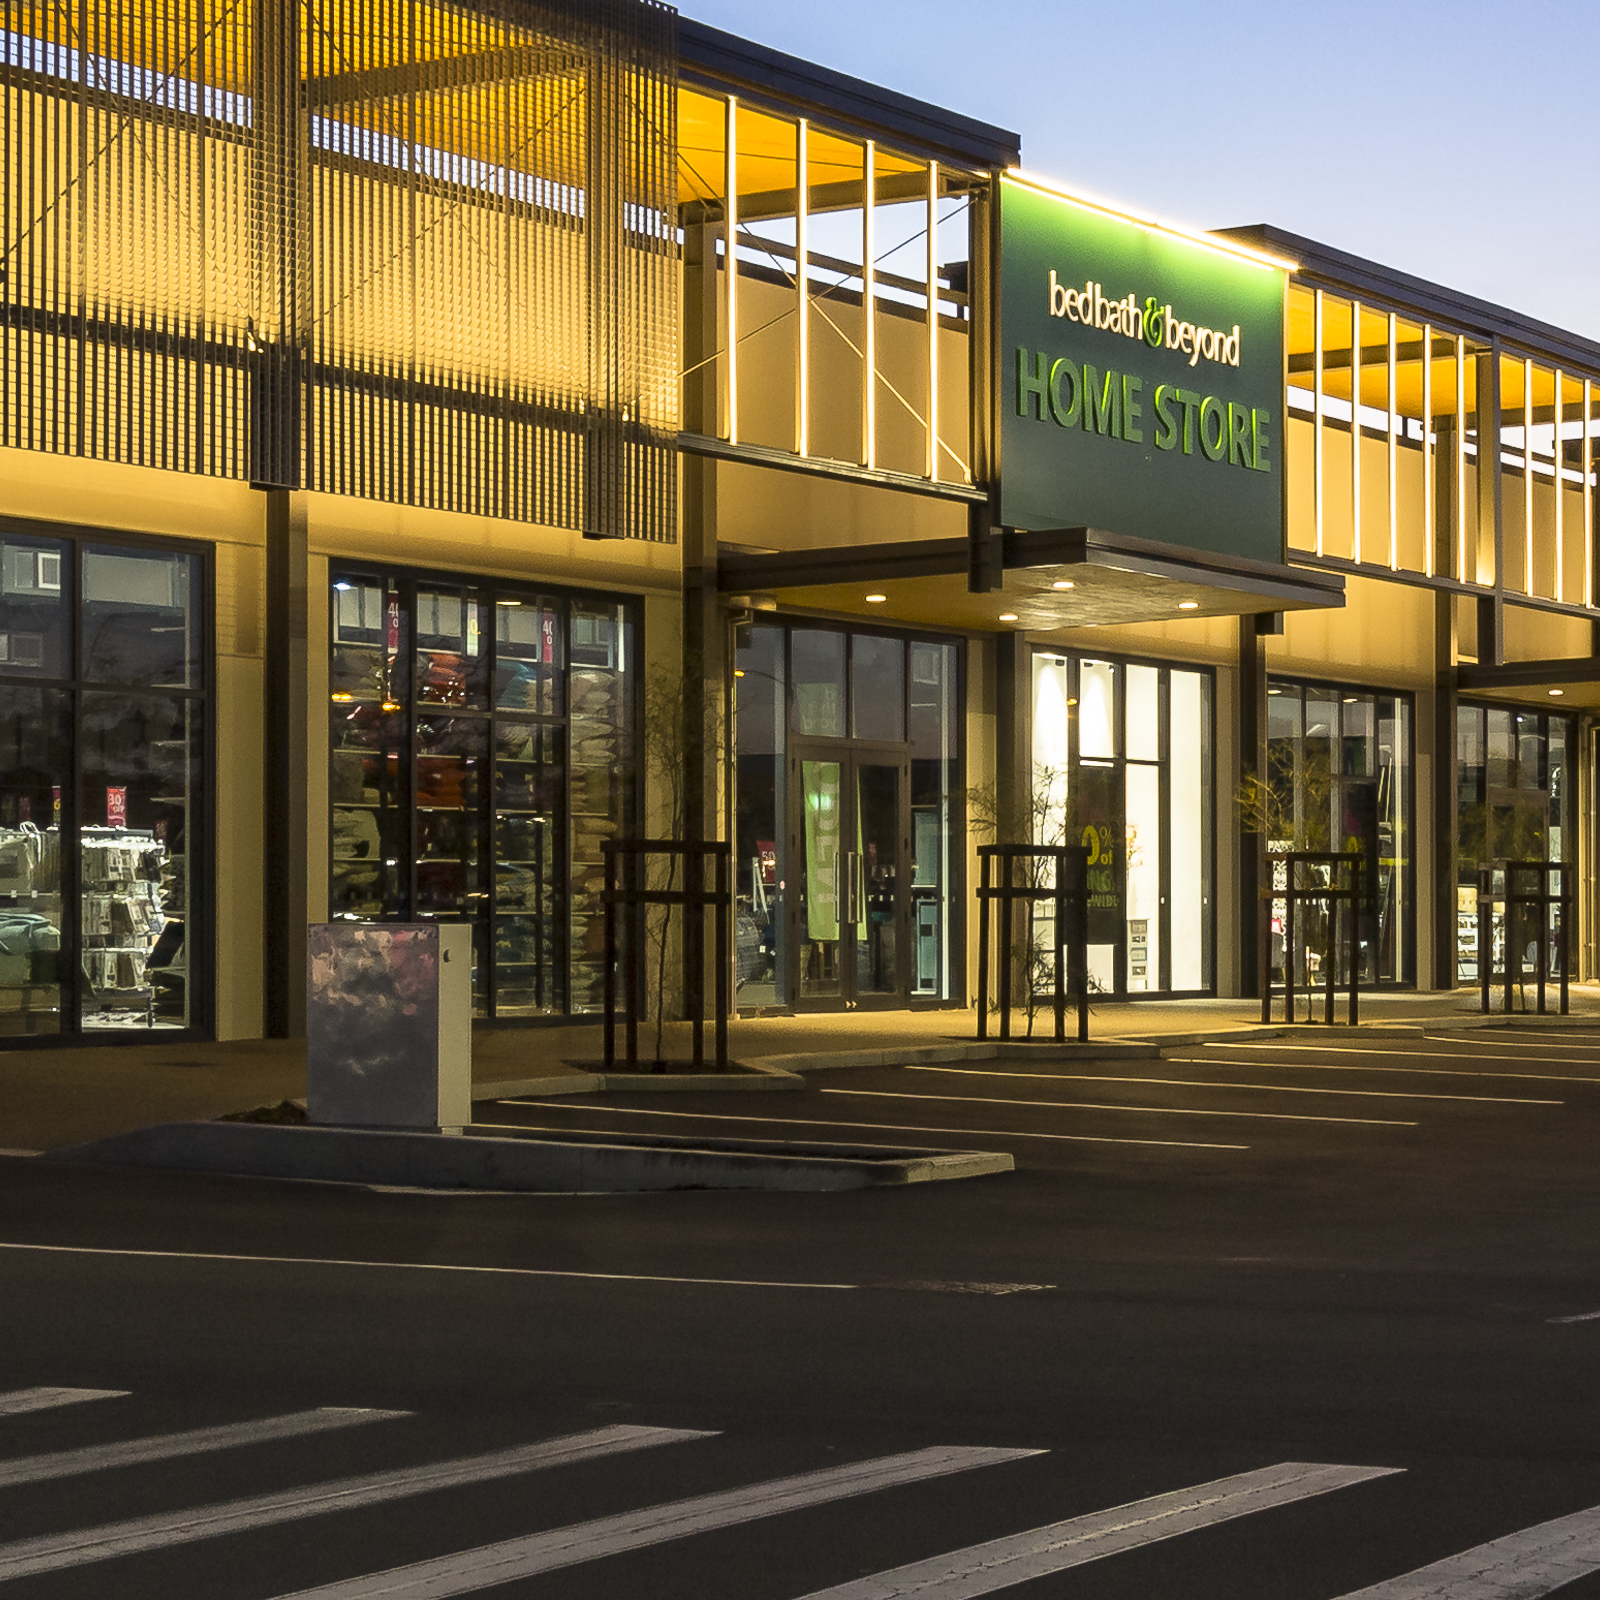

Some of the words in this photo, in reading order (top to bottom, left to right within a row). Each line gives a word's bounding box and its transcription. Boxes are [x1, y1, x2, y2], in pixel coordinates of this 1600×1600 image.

[1049, 269, 1241, 367] bedbath&beyond
[1015, 347, 1144, 444] HOME
[1154, 383, 1272, 473] STORE
